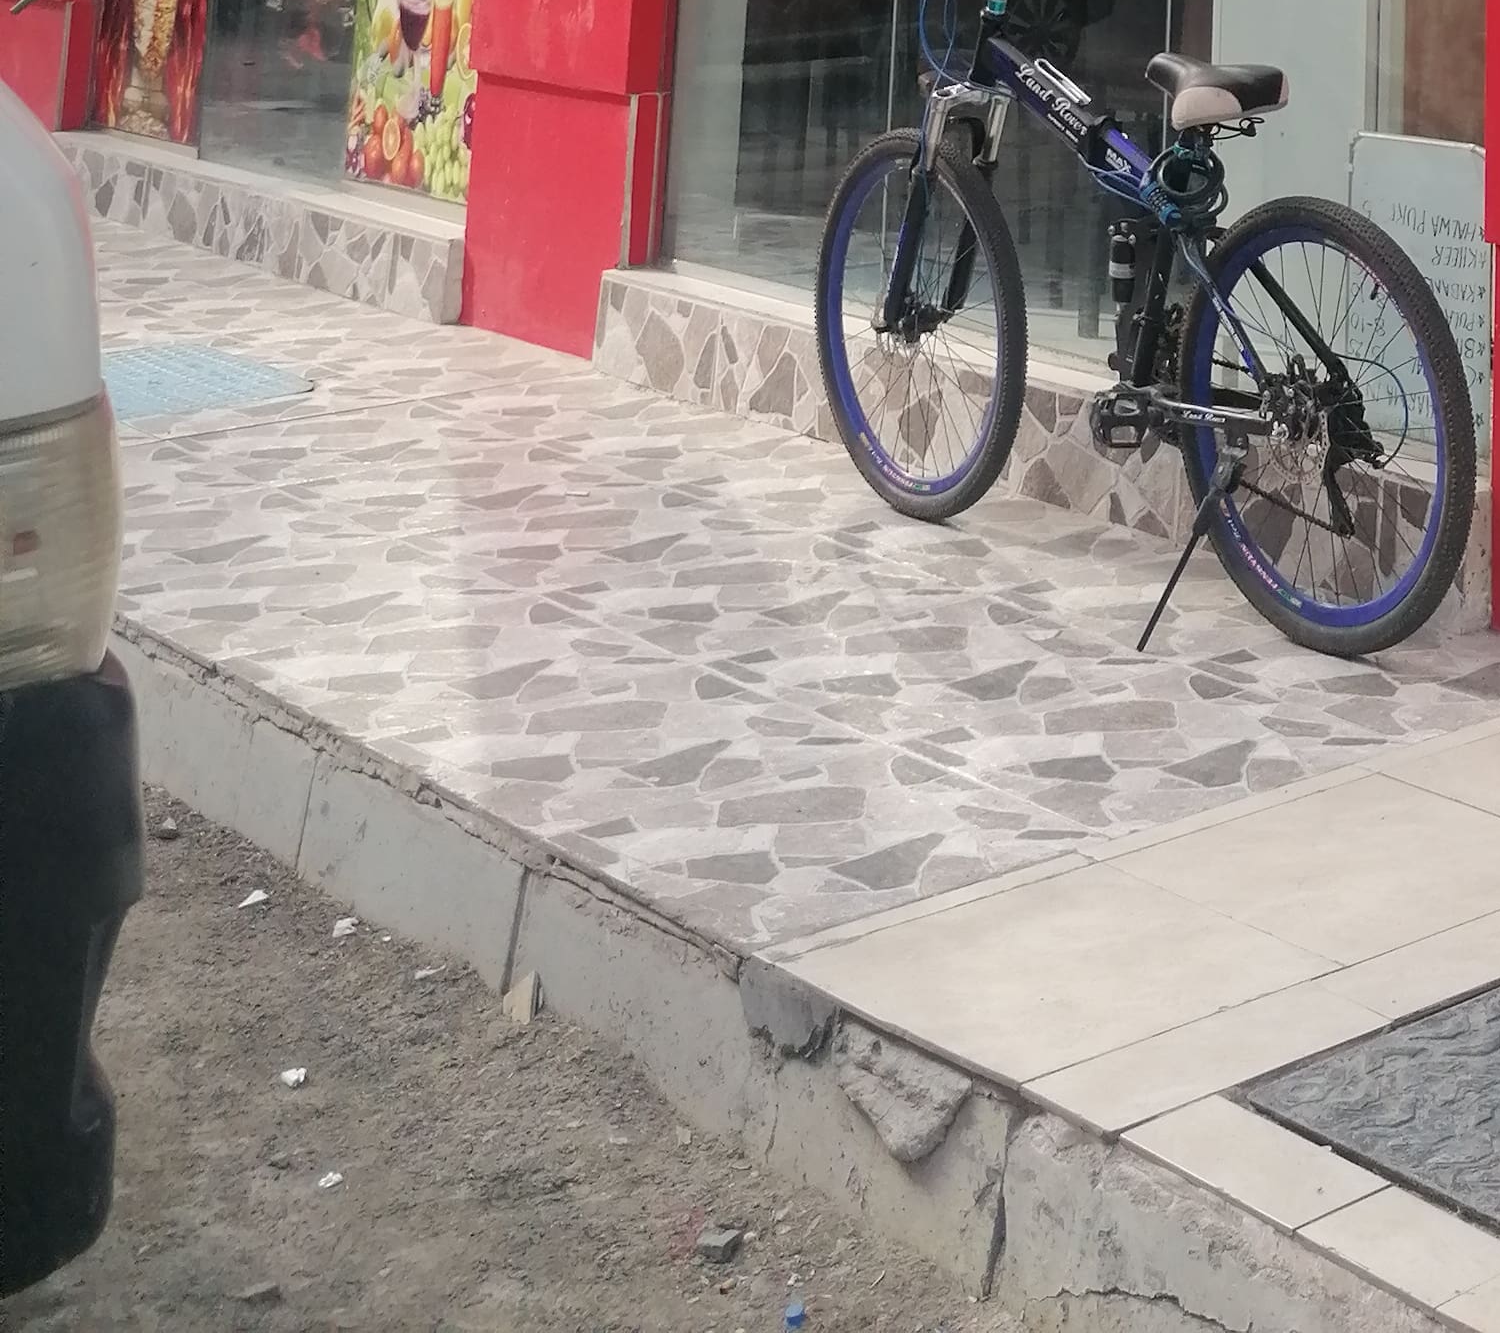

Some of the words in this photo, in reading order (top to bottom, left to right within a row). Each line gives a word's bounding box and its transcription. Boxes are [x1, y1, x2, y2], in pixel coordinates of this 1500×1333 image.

[1014, 63, 1054, 102] Land
[1051, 96, 1088, 136] Rover
[1105, 148, 1132, 174] MAX
